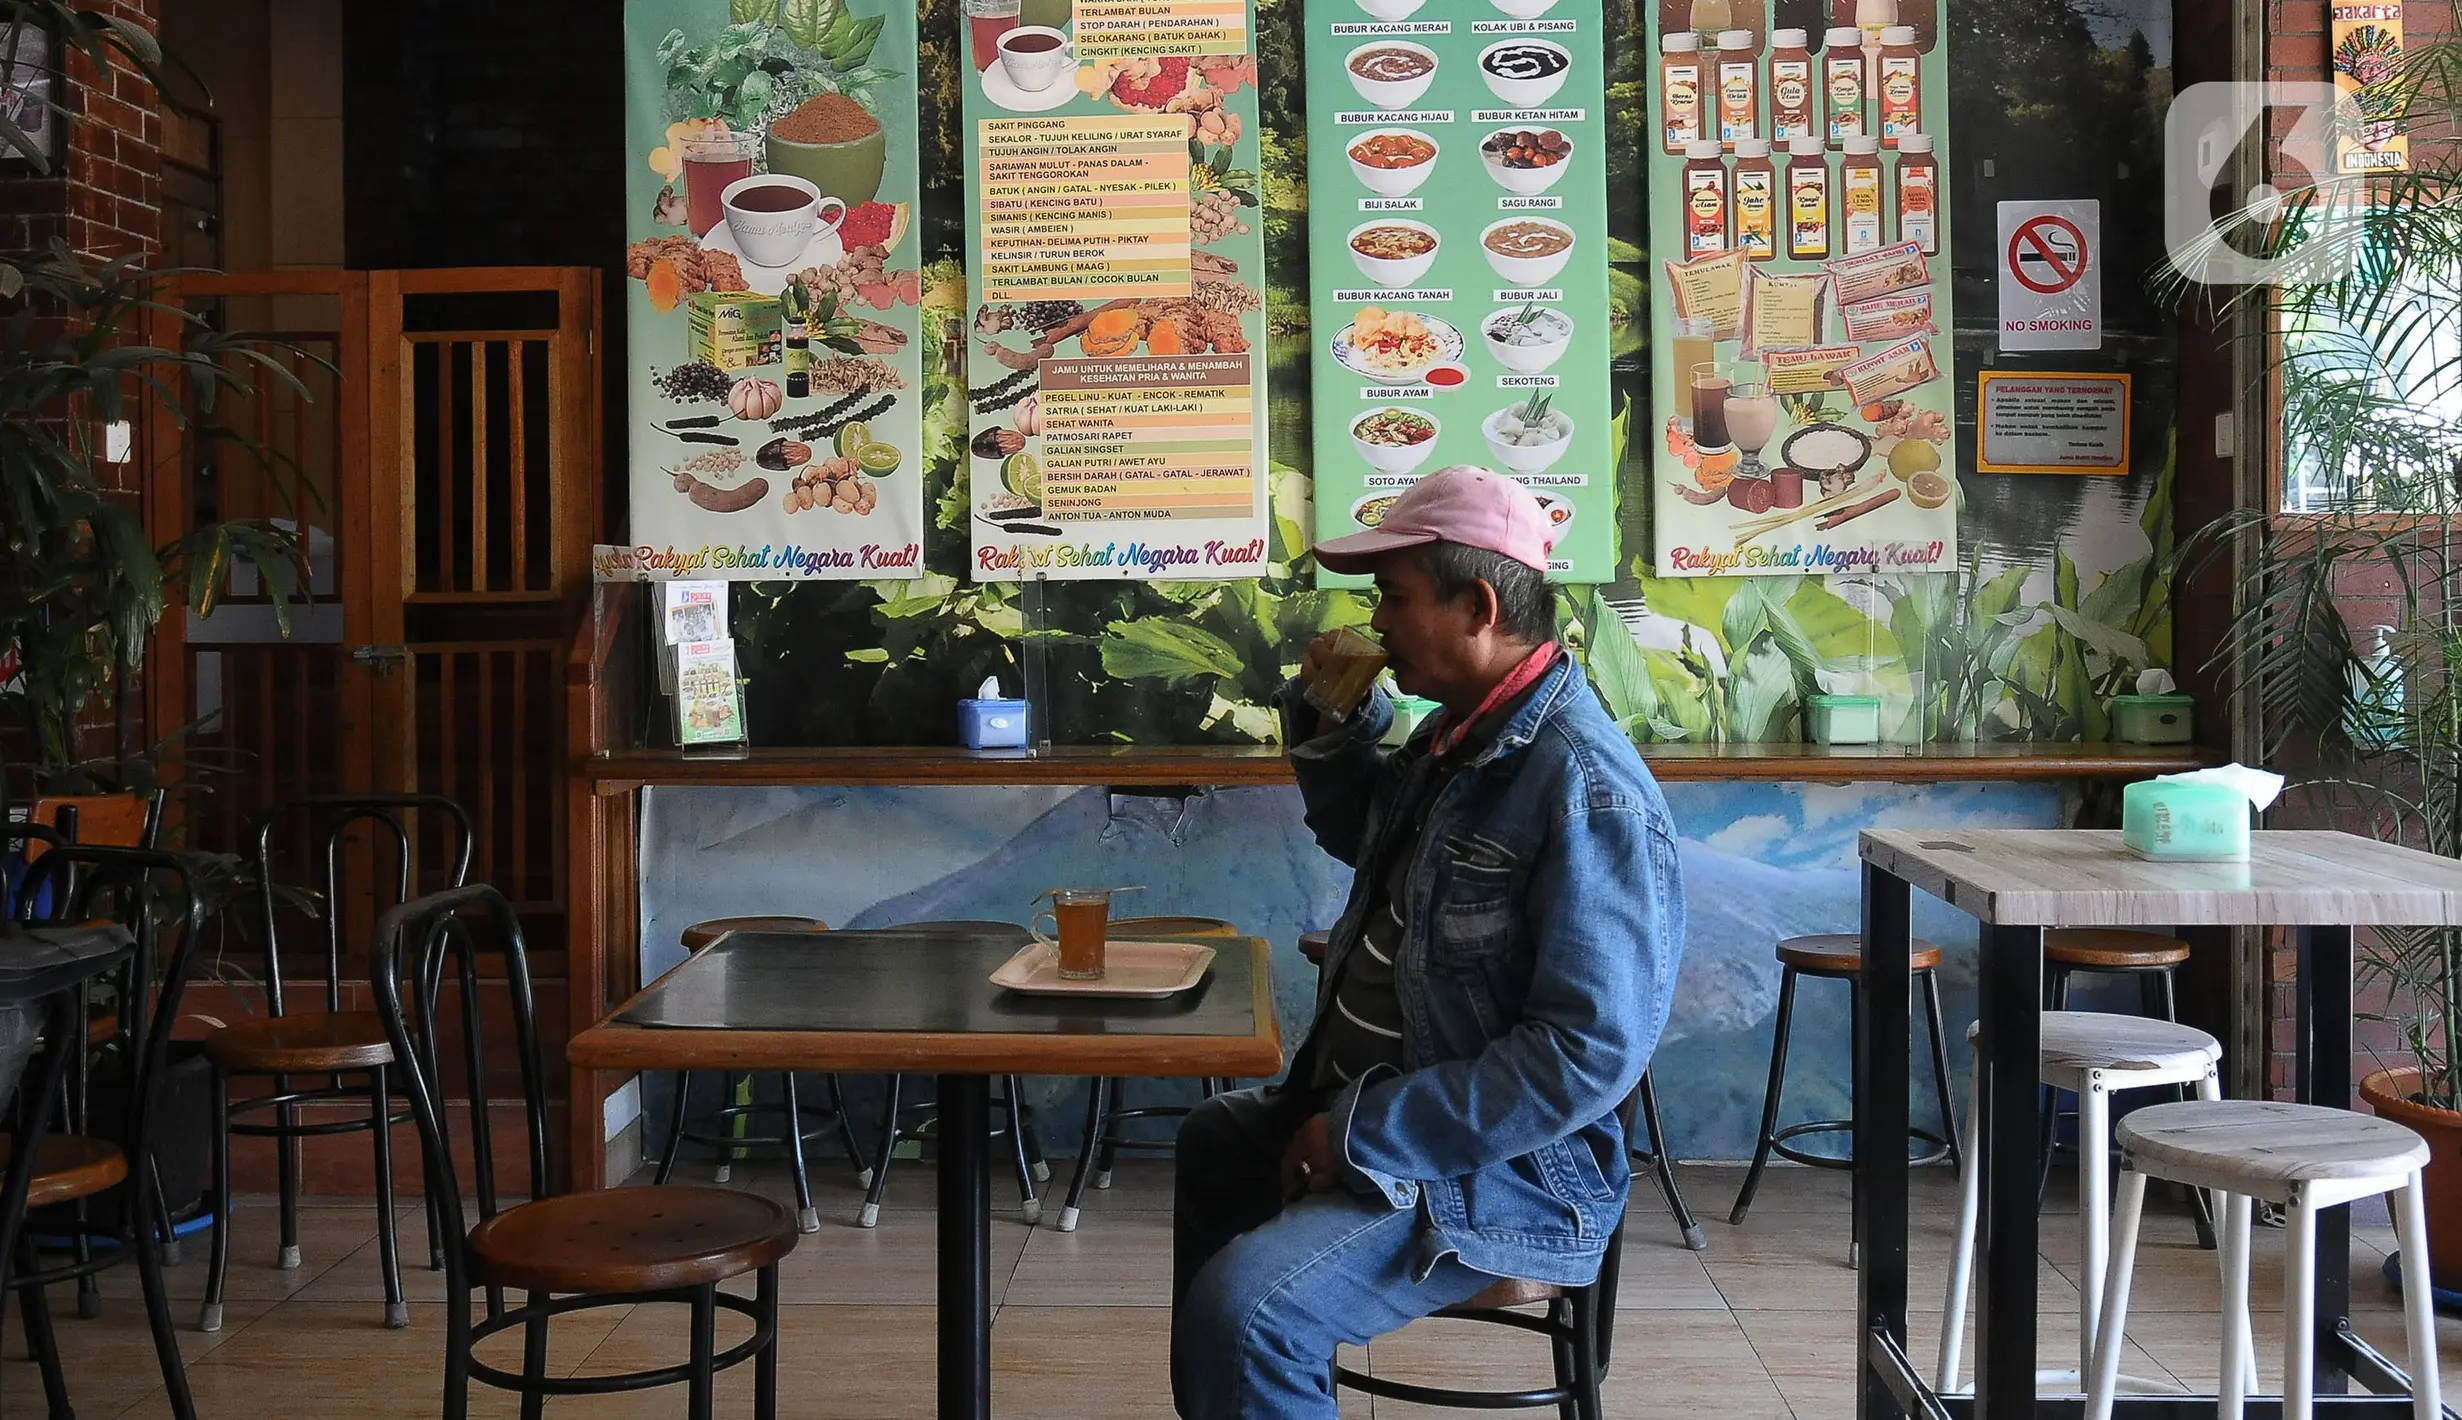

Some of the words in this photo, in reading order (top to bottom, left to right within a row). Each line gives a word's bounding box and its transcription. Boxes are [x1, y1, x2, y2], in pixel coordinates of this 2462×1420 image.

[1079, 7, 1136, 16] TERLAMBAT
[1138, 6, 1170, 15] BULAN
[1080, 21, 1105, 30] STOP
[1107, 20, 1140, 29] DARAH
[1148, 18, 1213, 28] PENDARAHAN
[1333, 25, 1367, 34] BUBUR
[1370, 24, 1411, 32] KACANG
[1413, 22, 1449, 32] MERAH
[1473, 23, 1507, 32] KOLAK
[1509, 22, 1526, 31] UBI
[1537, 22, 1575, 31] PISANG
[1080, 33, 1145, 43] SELOKARANG
[1153, 32, 1185, 41] BATUK
[1187, 30, 1220, 40] DAHAK
[1080, 47, 1118, 56] CINGKIT
[1168, 44, 1196, 54] SAKIT
[1340, 113, 1374, 122] BUBUR
[1376, 112, 1418, 122] KACANG
[1420, 112, 1448, 121] HIJAU
[1478, 111, 1512, 120] BUBUR
[1514, 111, 1546, 119] KETAN
[1548, 110, 1578, 119] HITAM
[988, 121, 1015, 130] SAKIT
[1017, 120, 1065, 129] PINGGANG
[988, 134, 1032, 143] SEKALOR
[1039, 133, 1069, 142] TUJUH
[1071, 132, 1112, 141] KELILING
[1119, 131, 1144, 140] URAT
[1146, 129, 1182, 138] SYARAF
[988, 147, 1018, 156] TUJUH
[1020, 146, 1048, 155] ANGIN
[1055, 145, 1086, 154] TOLAK
[1088, 144, 1117, 153] ANGIN
[988, 161, 1036, 171] SARIAWAN
[1039, 160, 1070, 169] MULUT
[1077, 159, 1108, 168] PANAS
[1110, 158, 1142, 167] DALAM
[2345, 152, 2402, 169] INDONESIA
[989, 171, 1016, 180] SAKIT
[1017, 169, 1089, 179] TENGGOROKAN
[989, 186, 1020, 195] BATUK
[1026, 185, 1055, 194] ANGIN
[1062, 184, 1092, 193] GATAL
[1099, 183, 1136, 192] NYESAK
[1144, 182, 1170, 190] PILEK
[990, 200, 1022, 209] SIBATU
[1030, 198, 1071, 207] KENCING
[1073, 197, 1097, 206] BATU
[1364, 200, 1382, 209] BIJI
[1384, 200, 1416, 209] SALAK
[1501, 199, 1526, 207] SAGU
[1528, 198, 1556, 207] RANGI
[990, 212, 1027, 222] SIMANIS
[1034, 211, 1076, 220] KENCING
[1078, 210, 1106, 219] MANIS
[990, 226, 1020, 234] WASIR
[1026, 224, 1068, 233] AMBEIEN
[1047, 237, 1081, 246] DELIMA
[1083, 236, 1110, 244] PUTIH
[1117, 235, 1149, 243] PIKTAY
[990, 251, 1032, 260] KELINSIR
[1039, 250, 1070, 258] TURUN
[1072, 249, 1104, 258] BEROK
[991, 264, 1019, 273] SAKIT
[1021, 263, 1068, 272] LAMBUNG
[1076, 262, 1104, 271] MAAG
[1684, 262, 1732, 277] TEMULAWAK
[991, 276, 1048, 286] TERLAMBAT
[1050, 276, 1082, 285] BULAN
[1090, 274, 1124, 284] COCOK
[1126, 273, 1159, 282] BULAN
[991, 291, 1012, 300] DLL.
[1337, 291, 1371, 300] BUBUR
[1373, 291, 1414, 300] KACANG
[1417, 291, 1449, 299] TANAH
[1500, 291, 1534, 300] BUBUR
[1536, 291, 1557, 299] JALI
[2005, 321, 2025, 332] NO
[2029, 319, 2093, 331] SMOKING
[1051, 365, 1078, 374] JAMU
[1080, 364, 1112, 373] UNTUK
[1114, 362, 1177, 372] MEMELIHARA
[1187, 360, 1242, 370] MENAMBAH
[1080, 373, 1135, 383] KESEHATAN
[1137, 372, 1160, 381] PRIA
[1170, 371, 1207, 380] WANITA
[1501, 376, 1554, 386] SEKOTENG
[1045, 393, 1076, 402] PEGEL
[1078, 392, 1099, 401] LINU
[1107, 391, 1132, 400] KUAT
[1142, 390, 1176, 399] ENCOK
[1183, 389, 1225, 398] REMATIK
[1366, 388, 1400, 397] BUBUR
[1402, 388, 1428, 397] AYAM
[1045, 406, 1079, 415] SATRIA
[1086, 405, 1116, 414] SEHAT
[1124, 404, 1149, 413] KUAT
[1151, 403, 1197, 412] LAKI-LAKI
[1046, 419, 1076, 428] SEHAT
[1078, 418, 1114, 427] WANITA
[1046, 432, 1099, 441] PATMOSARI
[1101, 431, 1132, 440] RAPET
[1046, 446, 1081, 455] GALIAN
[1083, 444, 1124, 454] SINGSET
[1046, 459, 1081, 468] GALIAN
[1084, 458, 1111, 467] PUTRI
[1118, 457, 1145, 466] AWET
[1146, 457, 1165, 465] AYU
[1047, 472, 1081, 481] BERSIH
[1084, 471, 1117, 480] DARAH
[1124, 470, 1155, 479] GATAL
[1162, 469, 1193, 478] GATAL
[1200, 468, 1244, 477] JERAWAT
[1532, 476, 1580, 484] THAILAND
[1368, 477, 1395, 486] SOTO
[1047, 485, 1081, 494] GEMUK
[1083, 484, 1116, 493] BADAN
[1047, 498, 1101, 507] SENINJONG
[1048, 512, 1080, 520] ANTON
[1082, 511, 1102, 520] TUA
[1108, 510, 1140, 519] ANTON
[1143, 509, 1171, 518] MUDA
[634, 544, 709, 577] Rakyat
[711, 544, 769, 569] Sehat
[772, 544, 854, 576] Negara
[859, 543, 920, 569] Kuat!
[1056, 541, 1116, 568] Sehat
[1117, 541, 1199, 573] Negara
[1204, 538, 1265, 565] Kuat!
[1670, 544, 1743, 575] Rakyat
[1744, 543, 1803, 567] Sehat
